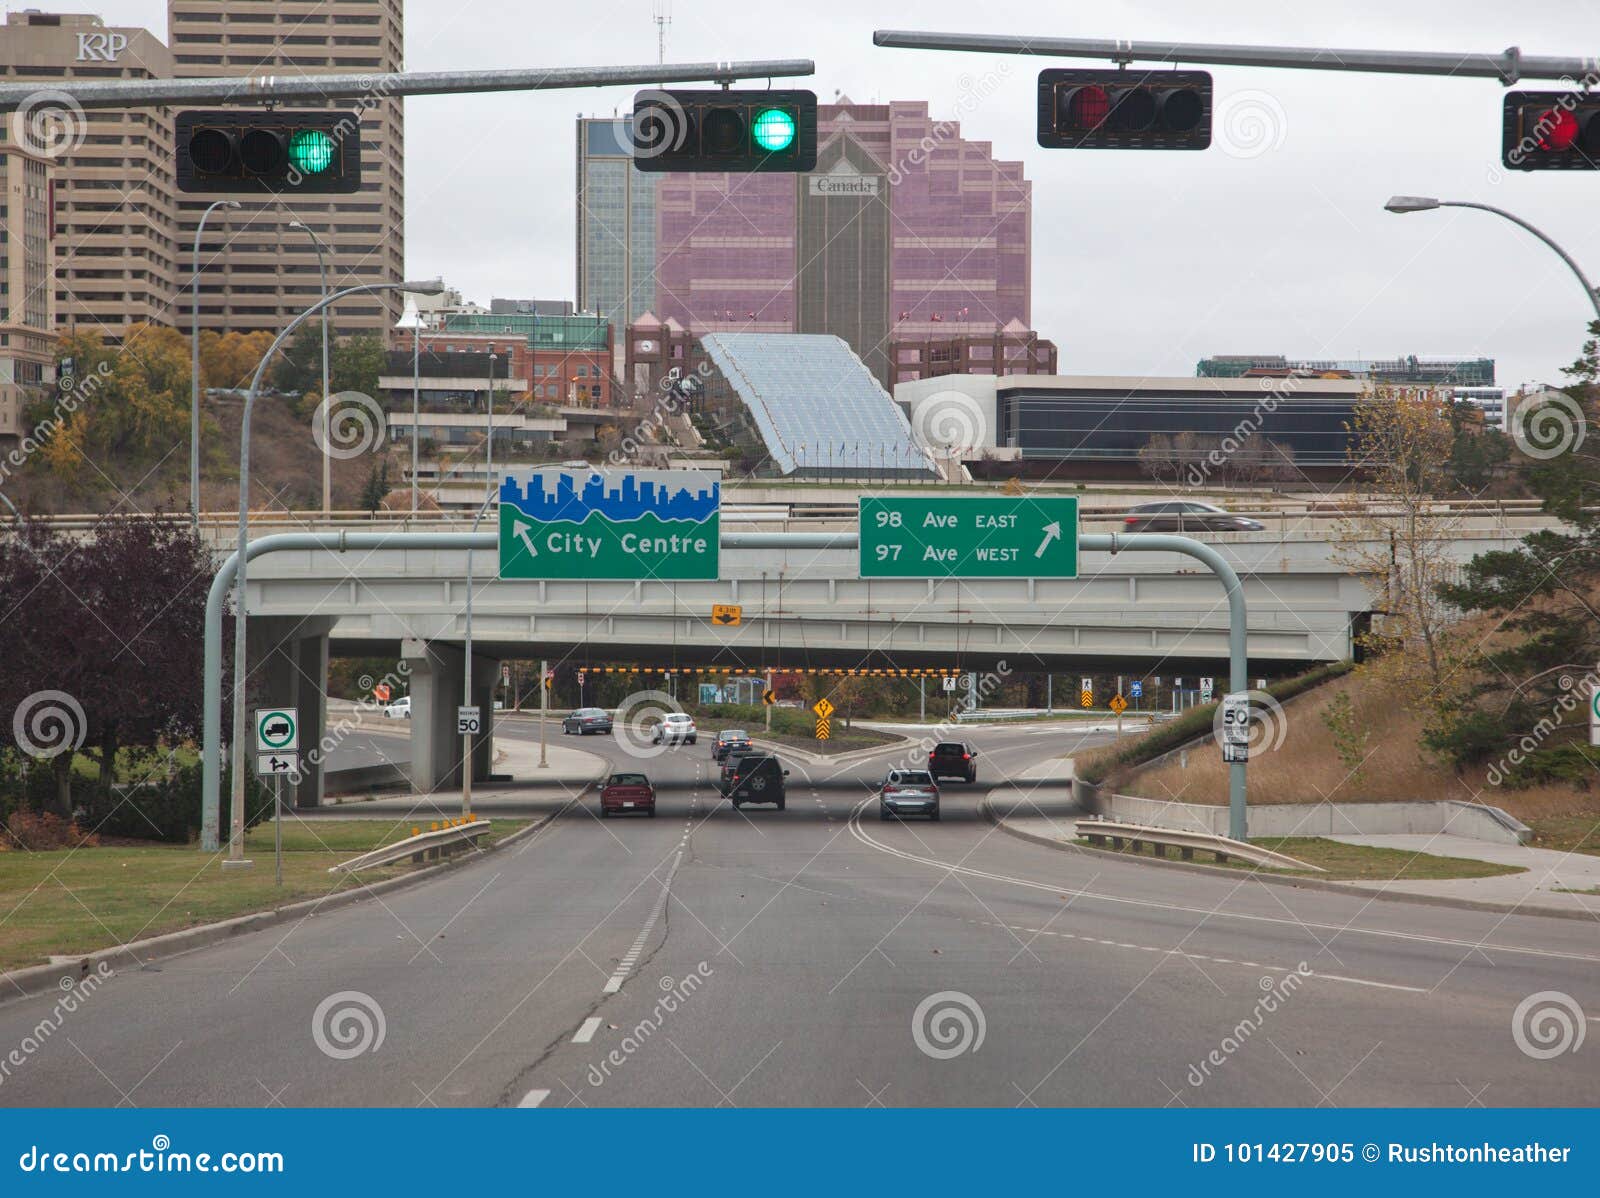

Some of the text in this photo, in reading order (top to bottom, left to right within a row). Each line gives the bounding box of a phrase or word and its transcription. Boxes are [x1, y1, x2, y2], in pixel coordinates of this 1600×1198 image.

[76, 32, 128, 62] KRP
[817, 178, 871, 192] Canada
[875, 511, 1018, 528] 98 Ave EAST
[546, 532, 708, 558] City Centre
[875, 545, 1020, 561] 97 Ave WEST
[1224, 709, 1248, 725] 50
[460, 719, 479, 732] 50
